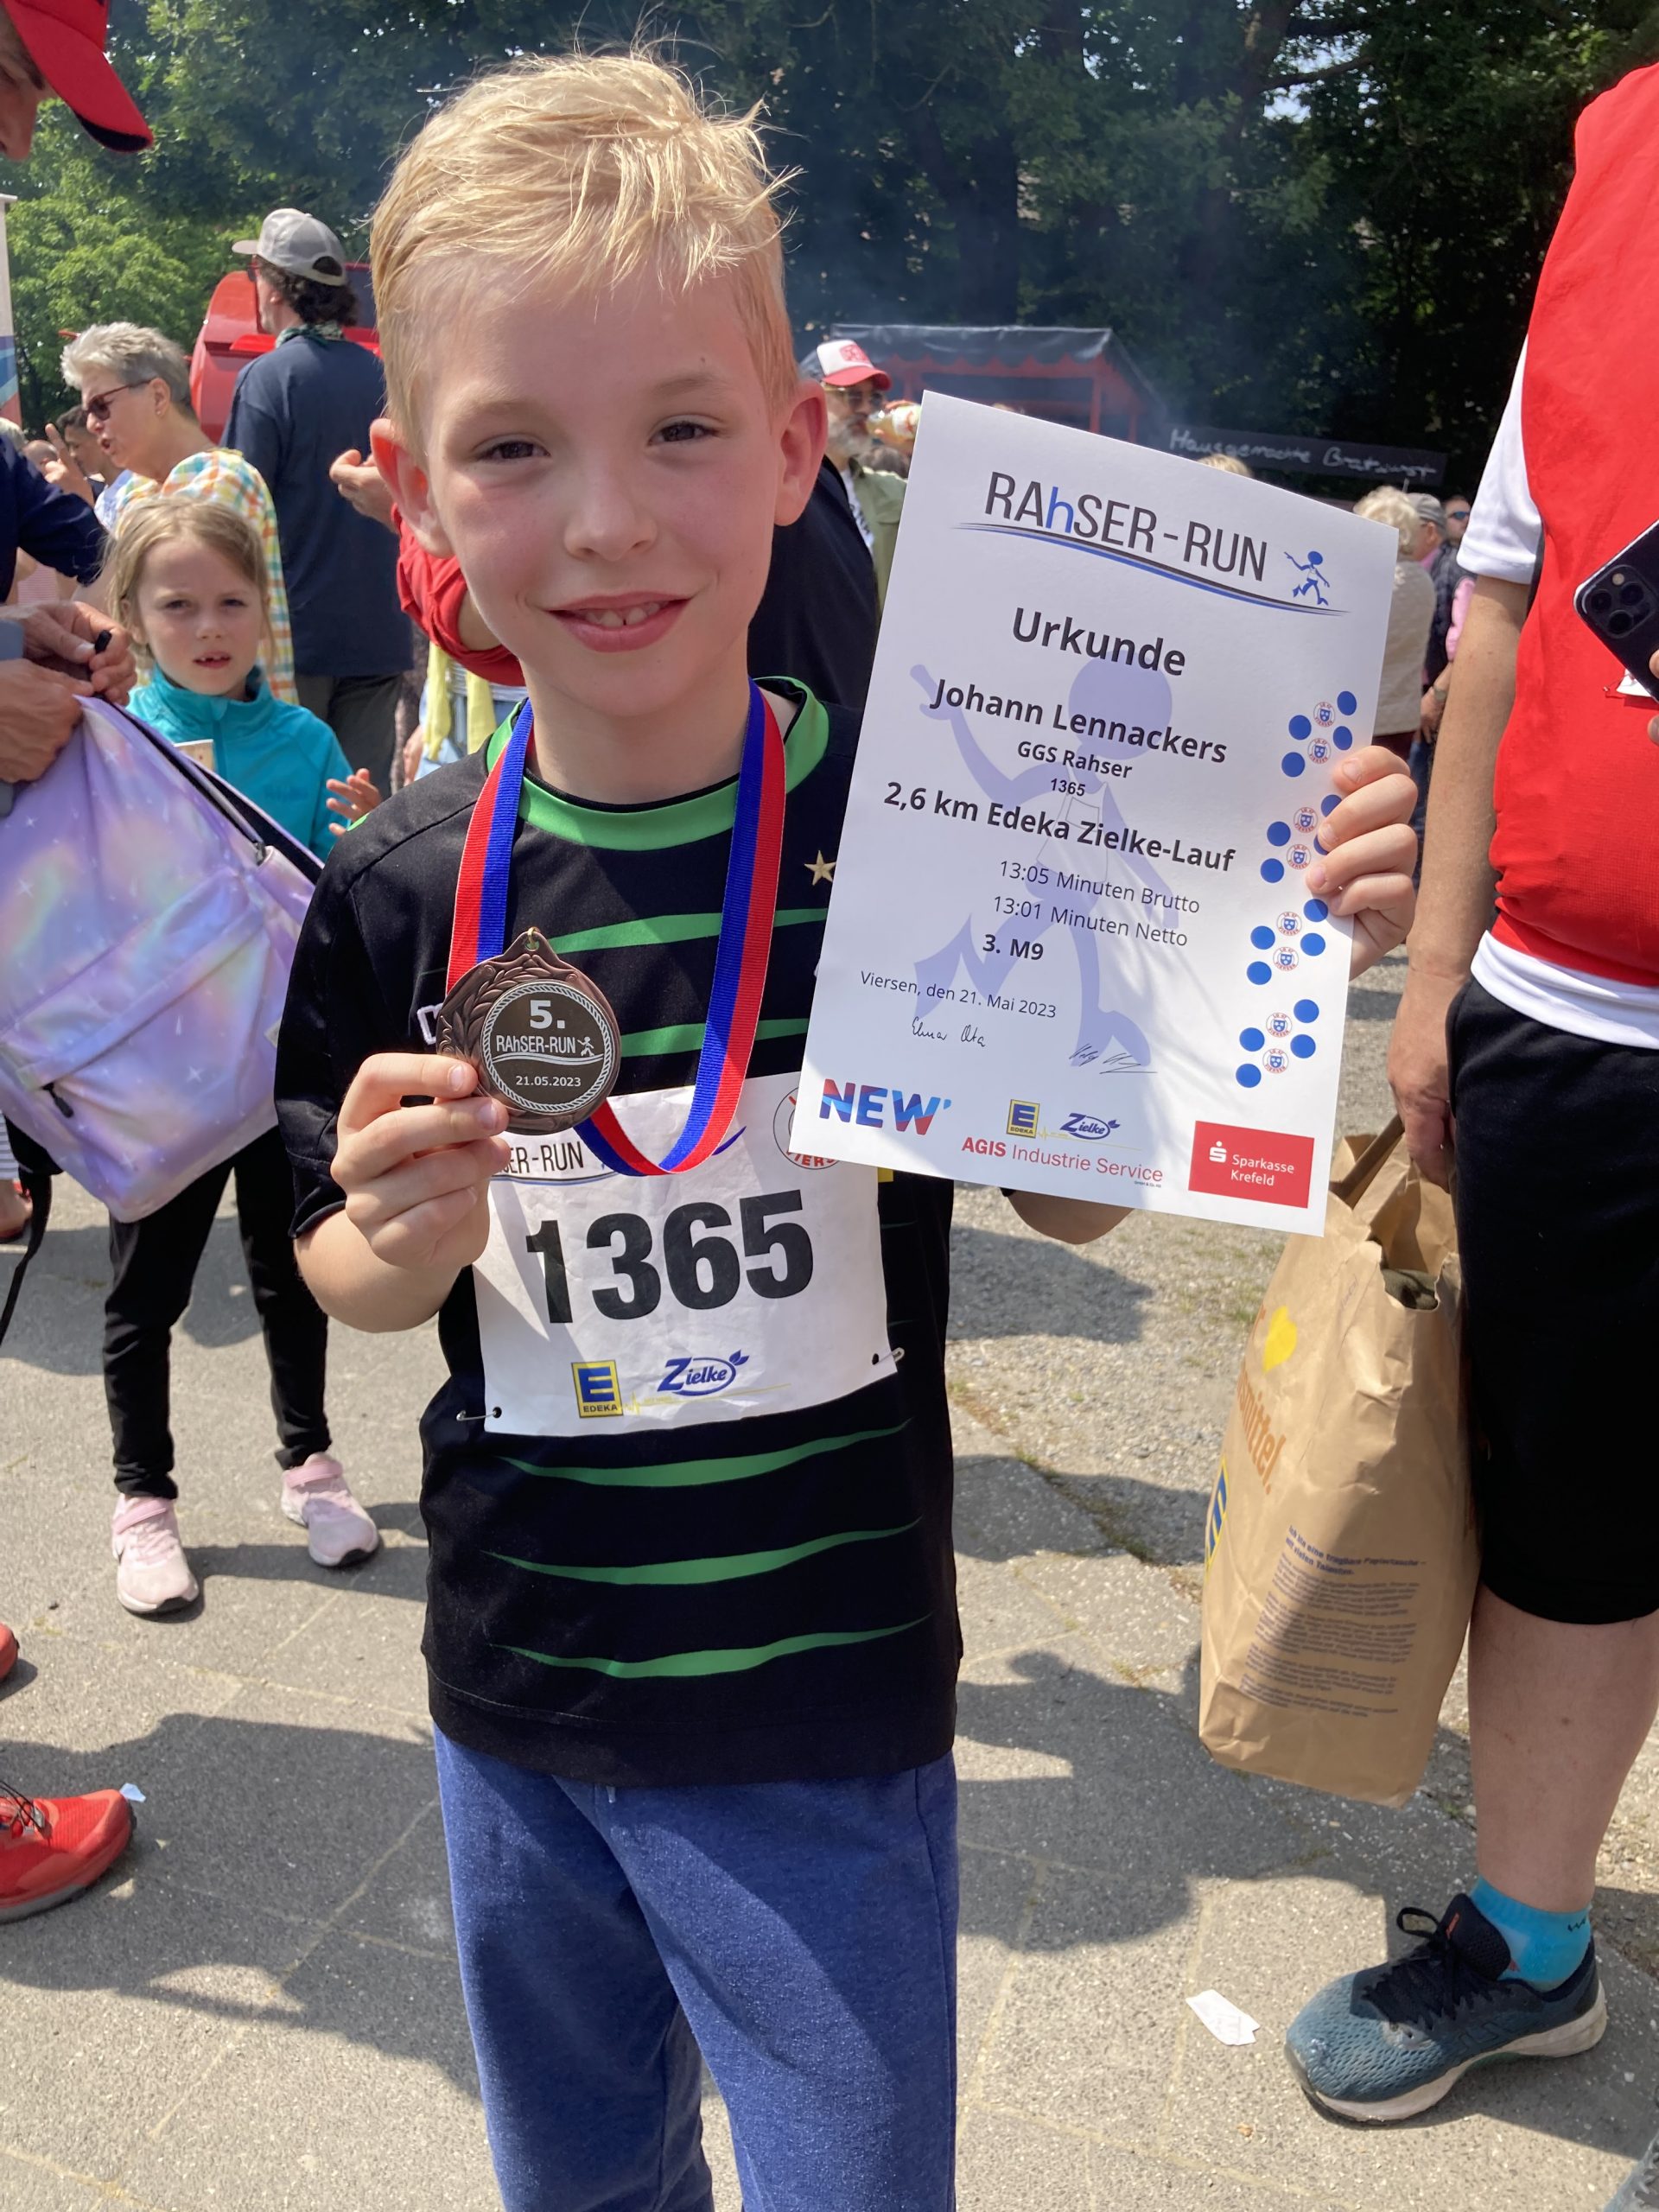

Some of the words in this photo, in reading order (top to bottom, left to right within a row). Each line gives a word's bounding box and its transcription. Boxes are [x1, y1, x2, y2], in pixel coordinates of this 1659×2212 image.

[1012, 607, 1186, 677] Urkunde
[929, 678, 1045, 725] Johann
[1052, 703, 1228, 764] Lennackers
[1017, 741, 1058, 763] GGS
[1062, 749, 1133, 779] Rahser
[1049, 778, 1086, 797] 1365
[884, 781, 926, 812] 2,6
[933, 795, 979, 822] km
[987, 802, 1071, 840] Edeka
[1077, 820, 1236, 873] Zielke-Lauf
[1000, 860, 1050, 886] 13:05
[1056, 871, 1135, 902] Minuten
[1141, 888, 1201, 914] Brutto
[993, 895, 1042, 920] 13:01
[1050, 906, 1129, 937] Minuten
[1135, 922, 1189, 947] Netto
[982, 933, 1001, 954] 3.
[1009, 938, 1045, 962] M9
[860, 970, 922, 996] Viersen,
[925, 982, 956, 1001] den
[958, 988, 982, 1007] 21.
[986, 994, 1015, 1012] Mai
[1018, 999, 1057, 1020] 2023
[529, 999, 566, 1029] 5.
[495, 1034, 576, 1054] RAhSER-RUN
[515, 1075, 582, 1087] 21.05.2023
[1009, 1126, 1034, 1136] EDEKA
[1059, 1112, 1106, 1136] Zielke
[504, 1141, 585, 1173] ER-RUN
[961, 1136, 1007, 1158] AGIS
[1012, 1144, 1091, 1172] Industrie
[1096, 1157, 1164, 1182] Service
[1231, 1154, 1294, 1174] Sparkasse
[1230, 1169, 1275, 1186] Krefeld
[524, 1189, 814, 1325] 1365
[656, 1357, 728, 1393] Zielke
[582, 1403, 619, 1413] EDEKA
